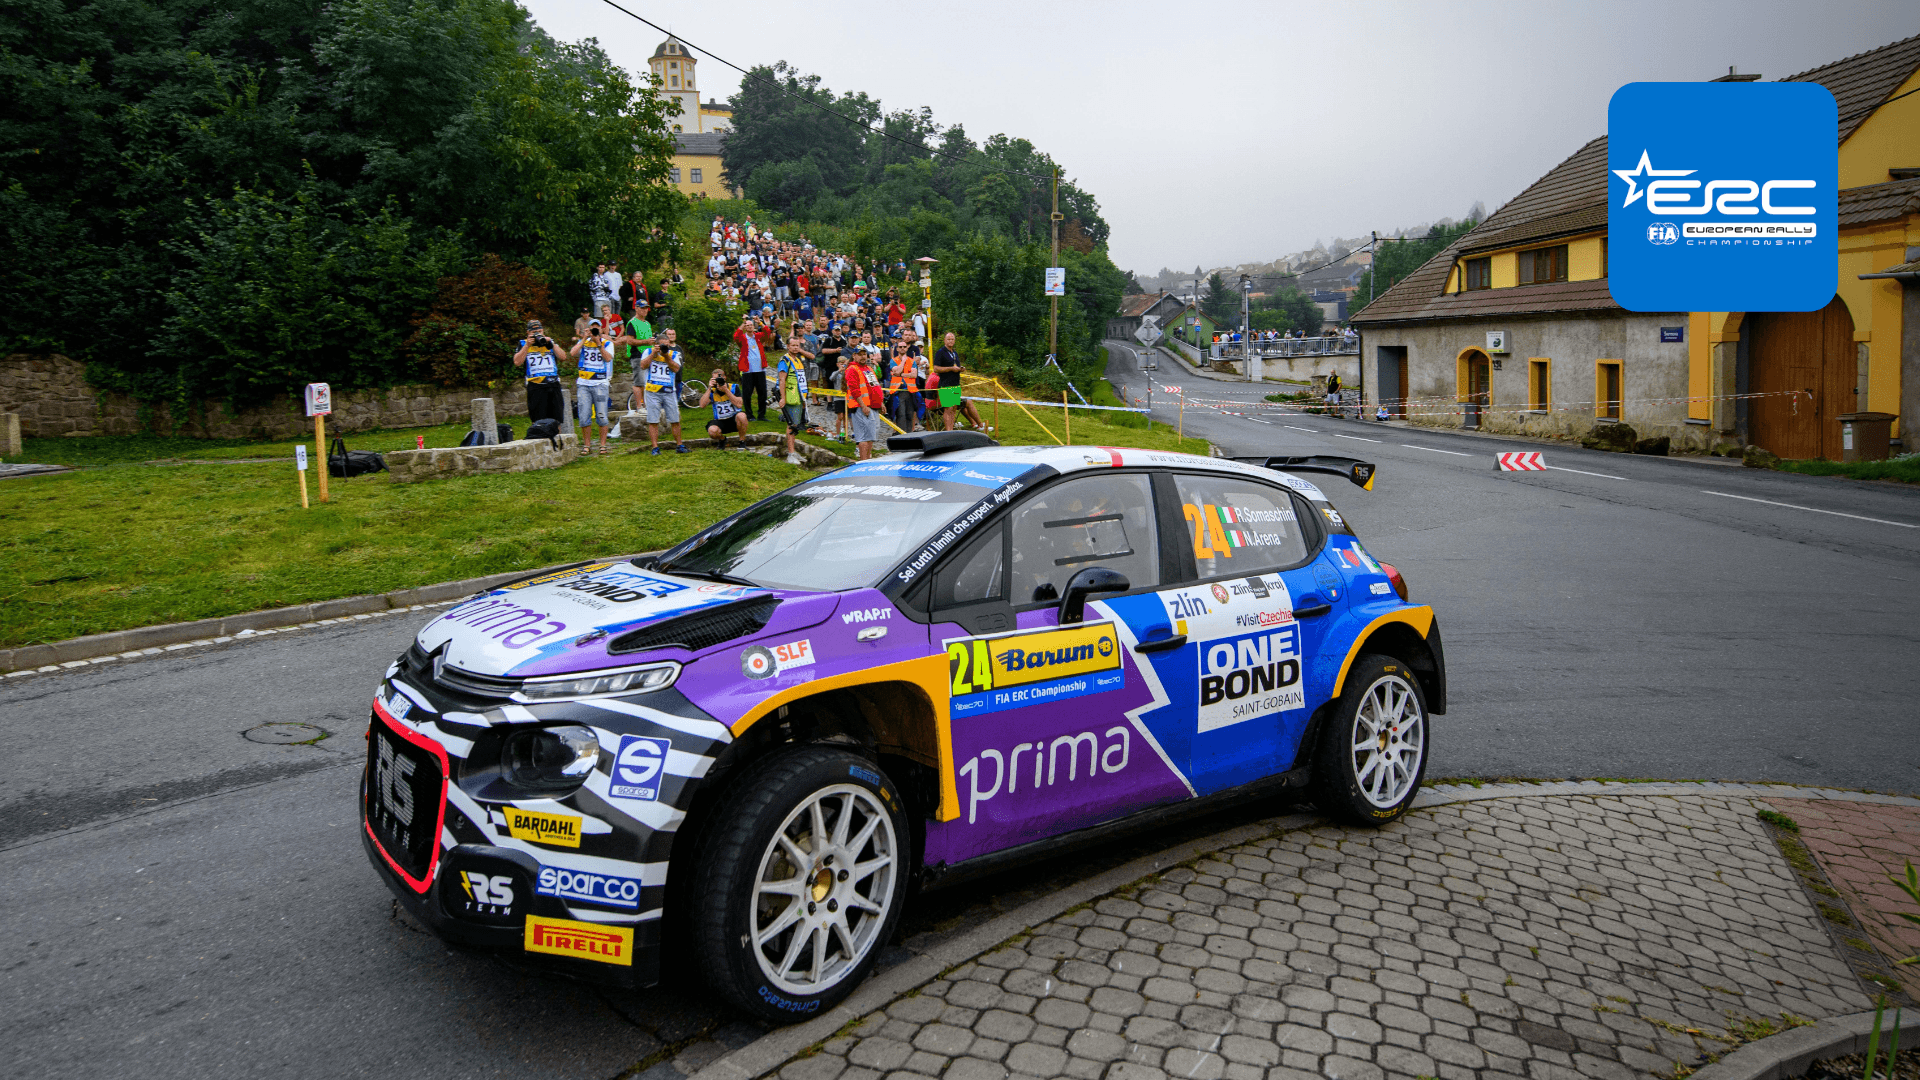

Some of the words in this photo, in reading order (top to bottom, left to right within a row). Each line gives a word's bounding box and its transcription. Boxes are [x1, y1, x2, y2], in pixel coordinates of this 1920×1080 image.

[529, 356, 551, 367] 271
[1323, 508, 1343, 523] RS
[911, 549, 934, 570] tutti
[930, 529, 957, 552] limiti
[953, 519, 970, 534] che
[1182, 503, 1232, 559] 24
[1243, 530, 1281, 547] N.Arena
[556, 580, 647, 603] BOND
[423, 600, 567, 649] prima
[842, 607, 892, 624] WRAP.IT
[1236, 608, 1292, 627] #VisitCzechia
[776, 640, 808, 662] SLF
[1003, 643, 1094, 672] Barum
[1207, 630, 1294, 675] ONE
[947, 639, 992, 696] 24
[995, 693, 1010, 705] FIA
[1012, 690, 1029, 701] ERC
[1031, 680, 1087, 698] Championship
[1200, 659, 1300, 707] BOND
[1232, 691, 1302, 719] SAINT-GOBAIN
[959, 726, 1130, 825] prima
[617, 786, 649, 798] sparco
[514, 815, 576, 839] BARDAHL
[466, 871, 514, 906] RS
[539, 868, 639, 901] sparco
[465, 902, 512, 916] TEAM
[533, 923, 624, 957] PIRELLI
